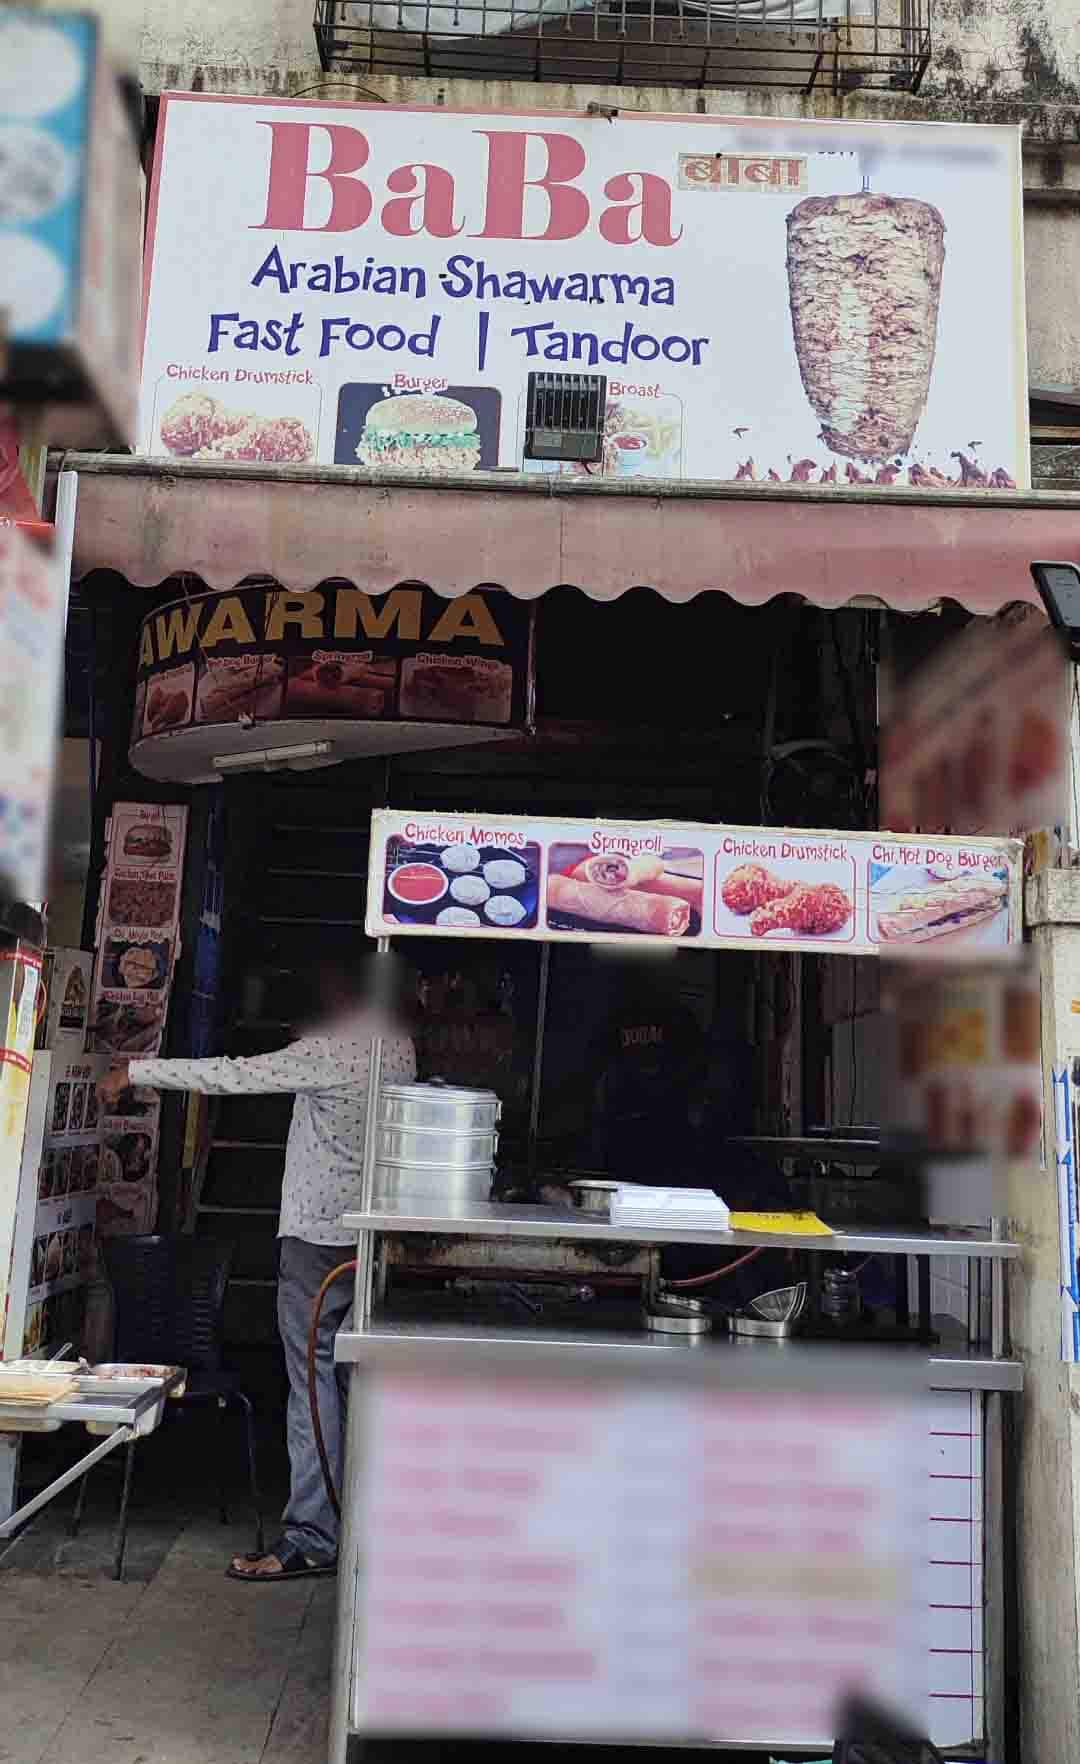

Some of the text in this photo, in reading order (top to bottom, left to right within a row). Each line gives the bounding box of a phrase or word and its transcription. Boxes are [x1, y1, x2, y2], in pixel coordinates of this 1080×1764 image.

[247, 119, 684, 247] BaBa
[250, 244, 675, 306] Arabian Shawarma
[207, 312, 303, 354] Fast
[318, 314, 441, 358] Food
[510, 321, 710, 365] Tandoor
[166, 364, 314, 385] Chicken Drumstick
[393, 373, 447, 392] Burger
[609, 382, 661, 398] Broast
[405, 823, 524, 846] Chicken Momos
[592, 832, 662, 856] Springroll
[722, 838, 847, 861] Chicken Drumstick
[927, 849, 953, 871] Dog
[959, 851, 1002, 872] Burger
